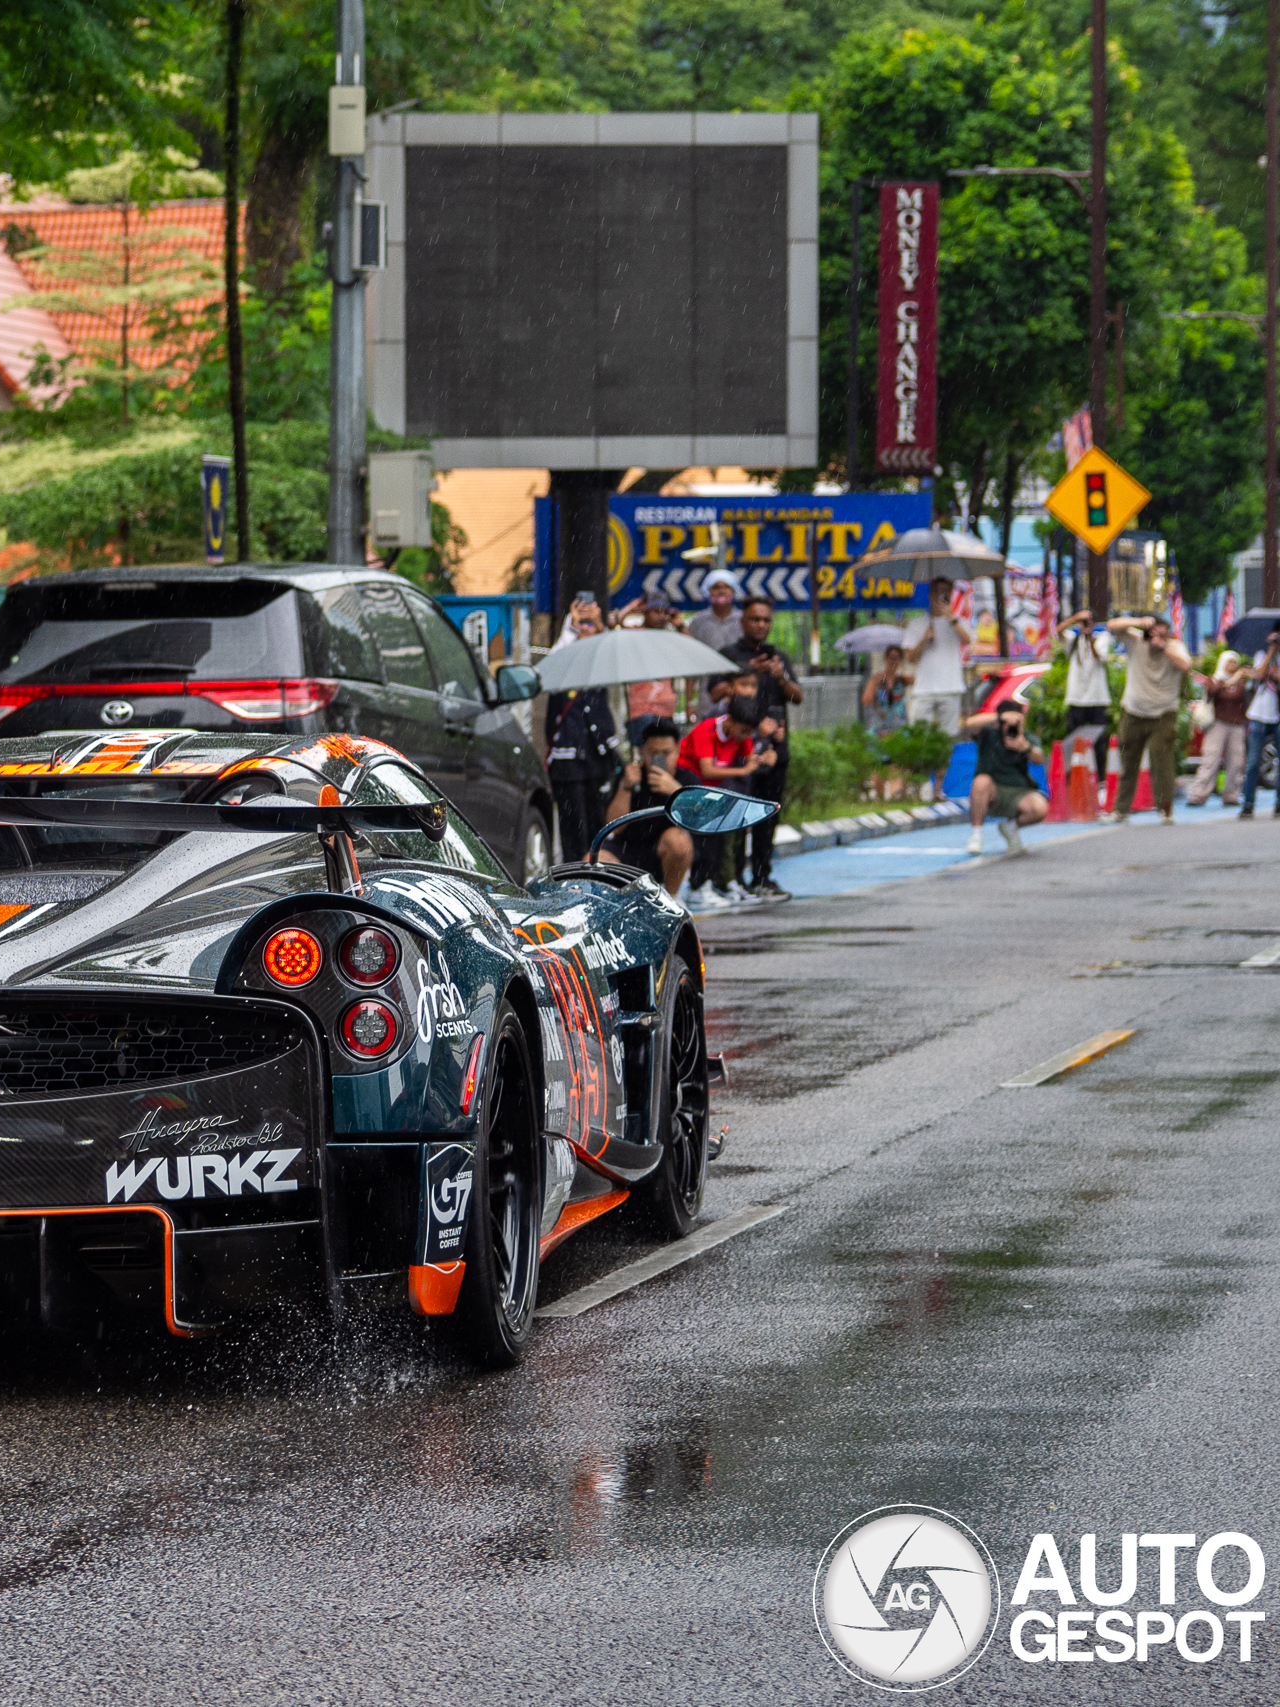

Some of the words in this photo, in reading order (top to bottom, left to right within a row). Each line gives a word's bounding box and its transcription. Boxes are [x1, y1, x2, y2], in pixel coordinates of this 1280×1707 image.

[896, 188, 923, 291] MONEY
[895, 301, 918, 443] CHANGER
[634, 506, 717, 524] RESTORAN
[817, 565, 856, 599] 24
[417, 951, 466, 1043] frsh
[119, 1106, 239, 1153] Huayra
[106, 1148, 302, 1203] WURKZ
[439, 1227, 462, 1239] INSTANT
[440, 1237, 460, 1249] COFFEE
